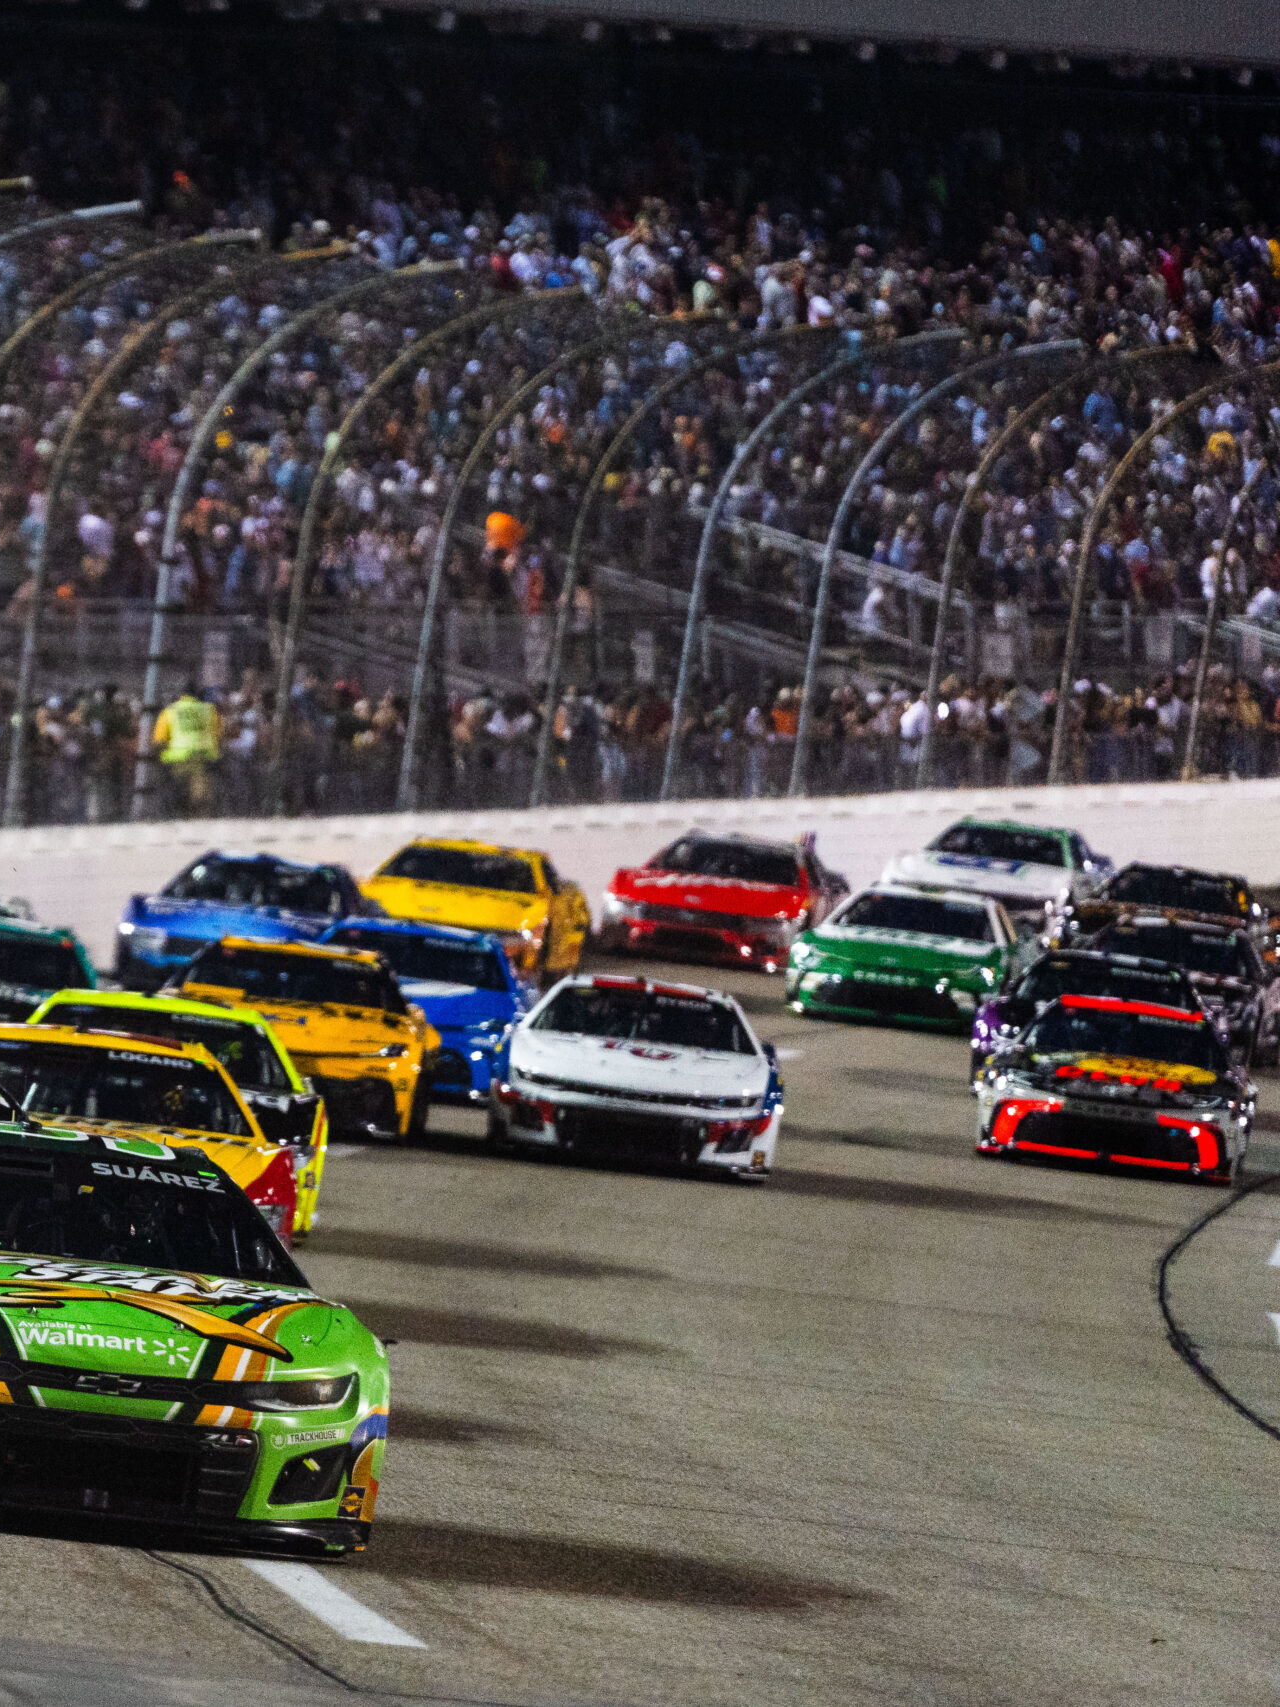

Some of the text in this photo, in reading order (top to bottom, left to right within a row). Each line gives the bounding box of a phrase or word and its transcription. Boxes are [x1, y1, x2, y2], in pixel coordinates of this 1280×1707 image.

[108, 1050, 193, 1070] LOGANO
[91, 1161, 226, 1194] SUÁREZ
[18, 1321, 92, 1331] Available at
[19, 1328, 147, 1354] Walmart
[289, 1432, 337, 1443] TRACKHOUSE
